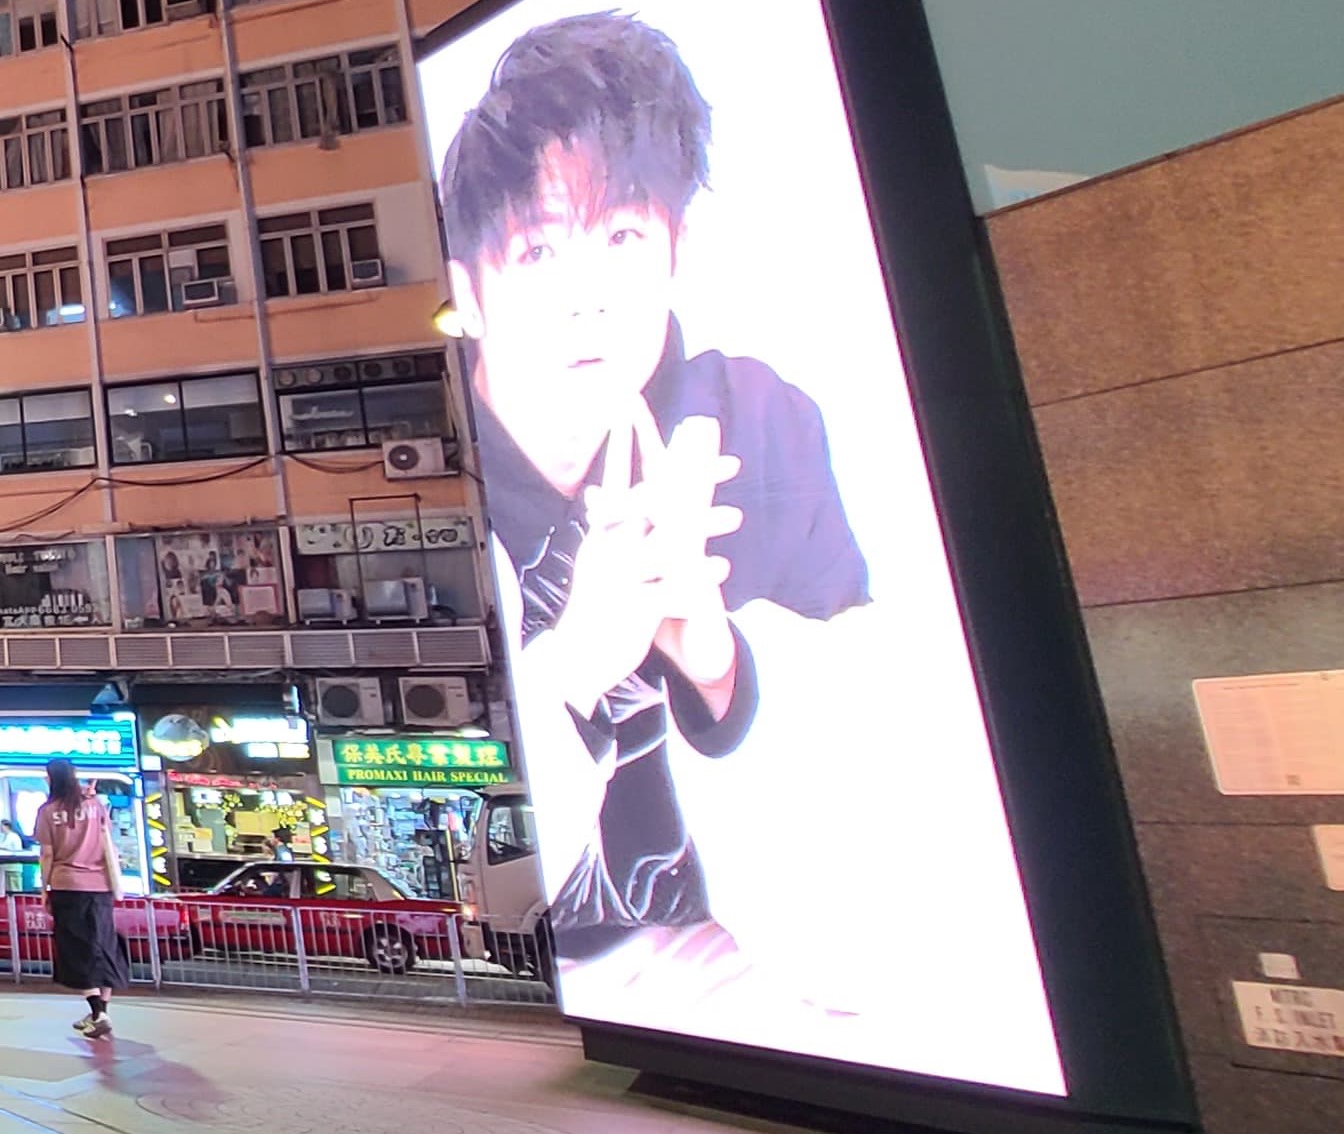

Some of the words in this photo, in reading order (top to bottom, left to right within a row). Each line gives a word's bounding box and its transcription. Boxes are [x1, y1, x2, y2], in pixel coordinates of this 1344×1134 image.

[348, 768, 407, 782] PROMAXI
[413, 769, 446, 782] HAIR
[450, 770, 509, 785] SPECIAL
